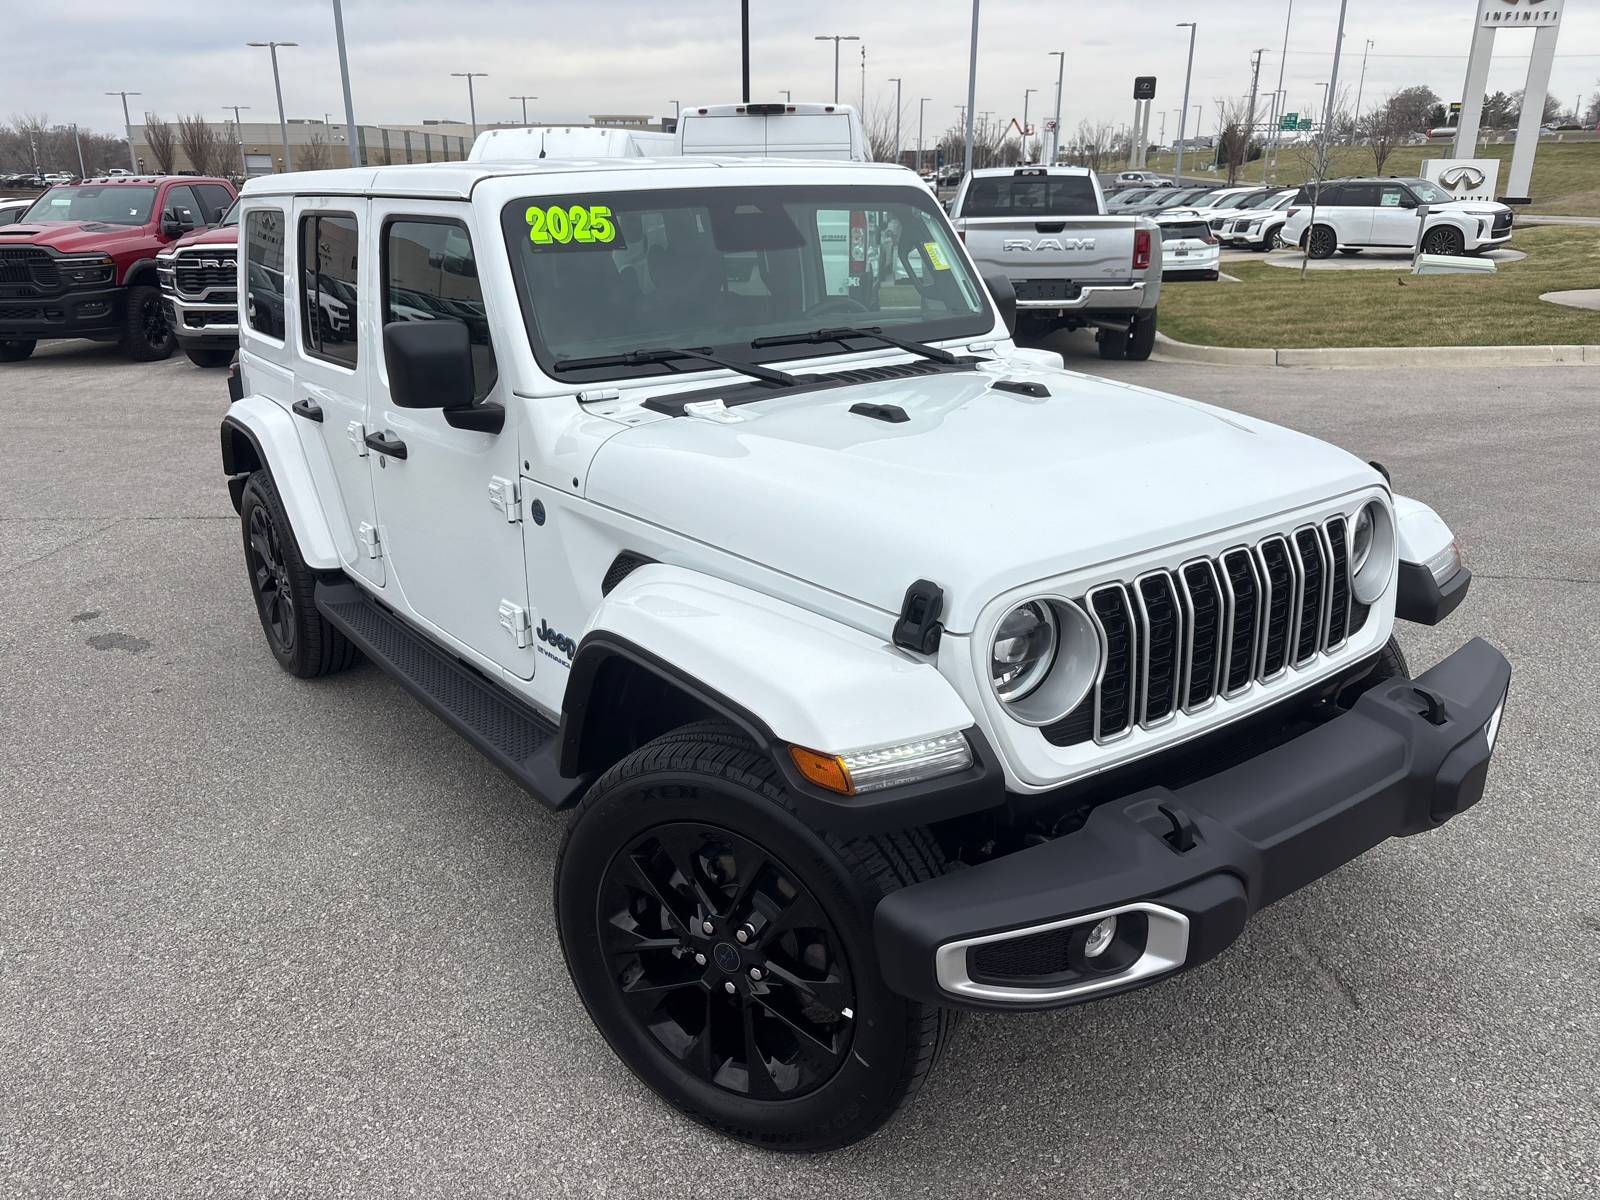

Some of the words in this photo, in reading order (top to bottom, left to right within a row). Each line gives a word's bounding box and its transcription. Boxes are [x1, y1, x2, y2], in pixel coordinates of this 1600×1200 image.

[1485, 11, 1558, 21] INFINITI
[525, 205, 616, 244] 2025
[1002, 238, 1096, 251] RAM
[201, 259, 238, 267] RA
[537, 618, 577, 661] Jeep
